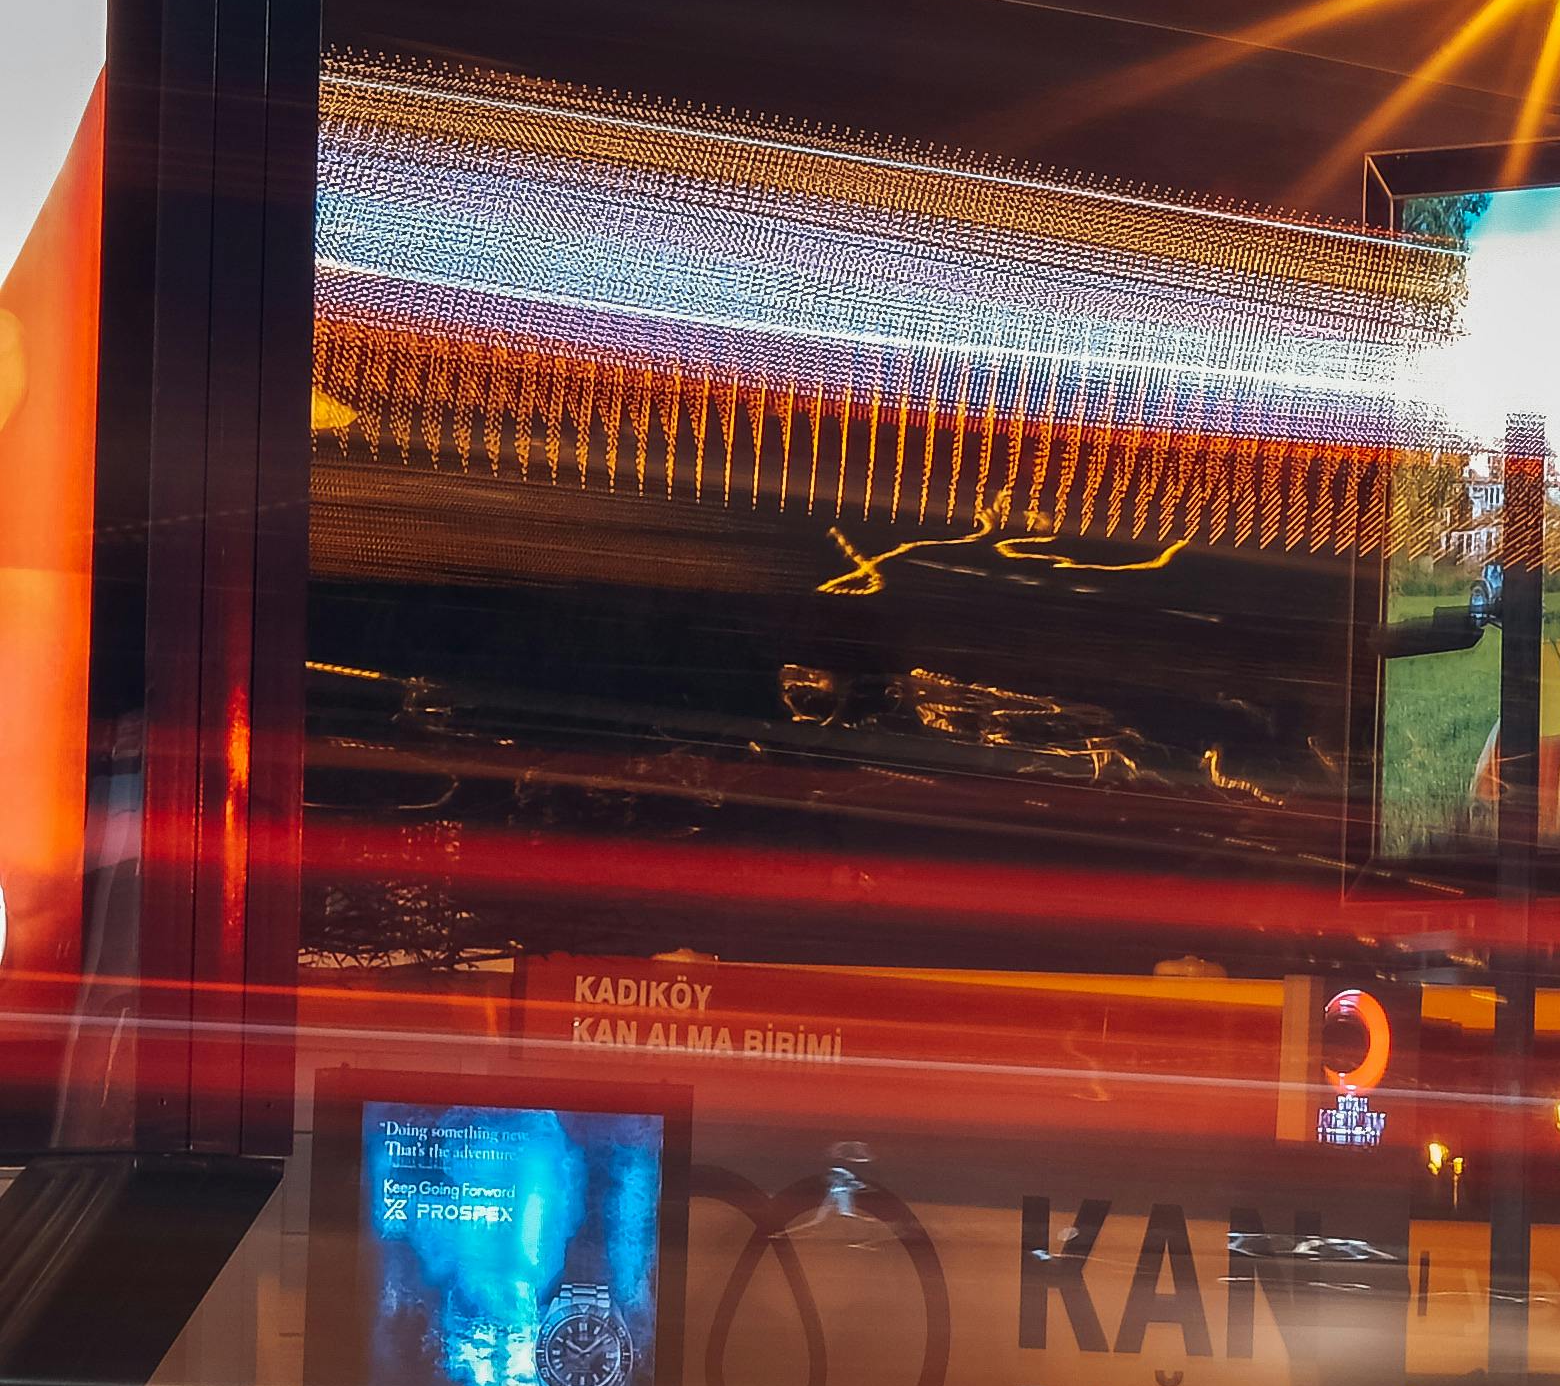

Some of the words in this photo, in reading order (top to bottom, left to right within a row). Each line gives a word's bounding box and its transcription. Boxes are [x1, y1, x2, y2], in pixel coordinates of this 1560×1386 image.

[575, 975, 712, 1012] KADIKÖY
[573, 1017, 638, 1049] KAN
[646, 1022, 735, 1055] ALMA
[744, 1023, 842, 1062] BİRİMİ
[431, 1124, 499, 1143] something
[384, 1140, 425, 1158] That's
[429, 1143, 450, 1158] the
[383, 1178, 417, 1198] Keep
[419, 1180, 459, 1200] Going
[462, 1182, 516, 1198] Forward
[417, 1203, 513, 1222] PROSPEX
[1018, 1194, 1322, 1360] KAN
